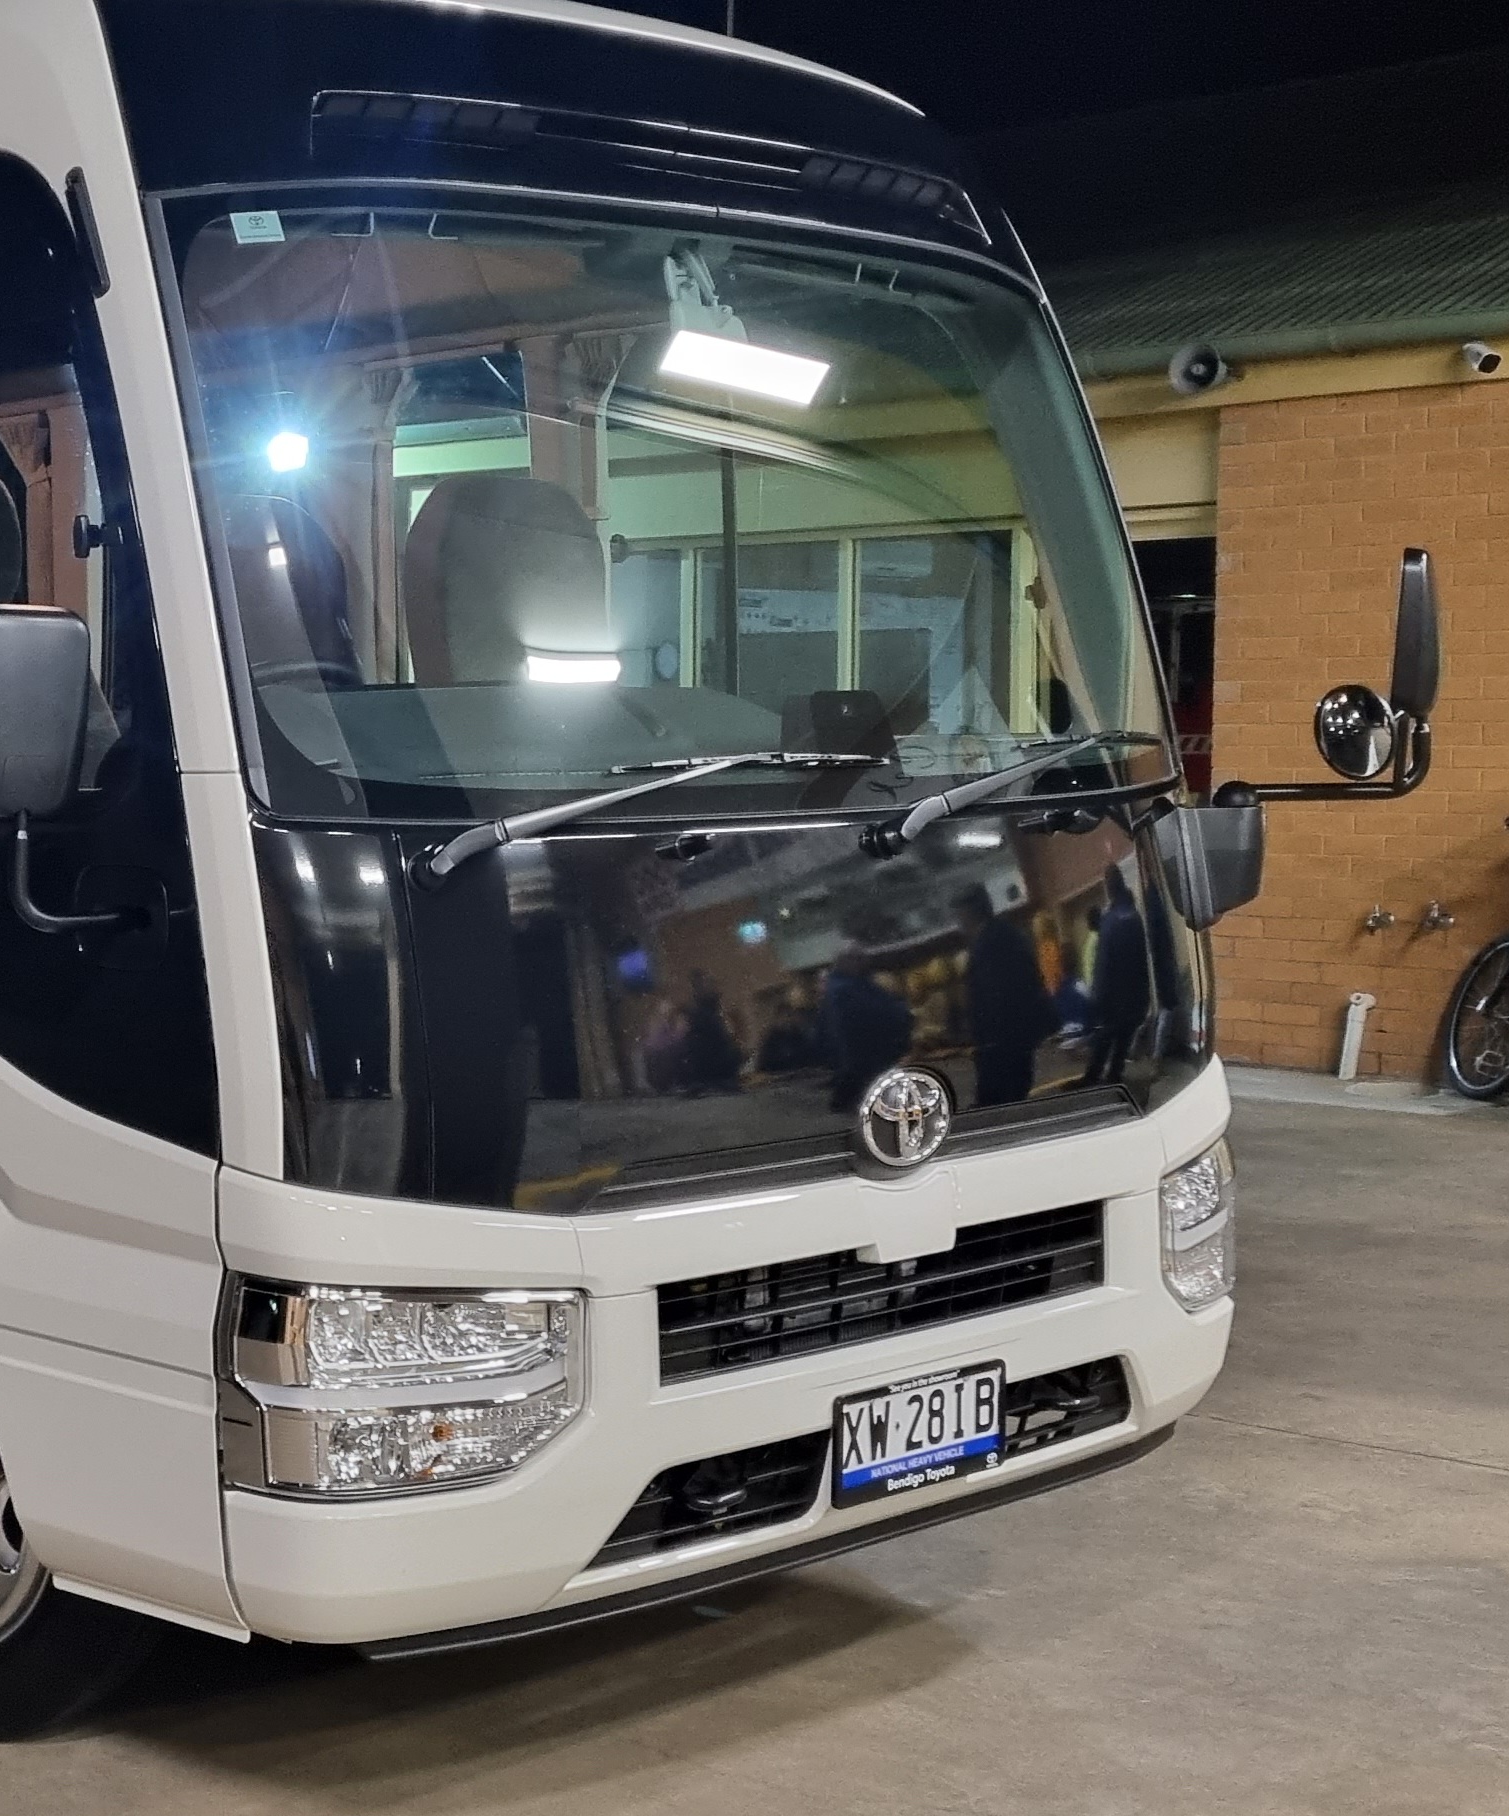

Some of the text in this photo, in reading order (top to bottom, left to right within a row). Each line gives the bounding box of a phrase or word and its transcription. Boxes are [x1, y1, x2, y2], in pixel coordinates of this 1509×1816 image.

[870, 1446, 965, 1478] NATIONAL HEAVY VEHICLE
[887, 1465, 955, 1491] Bendigo Toyota
